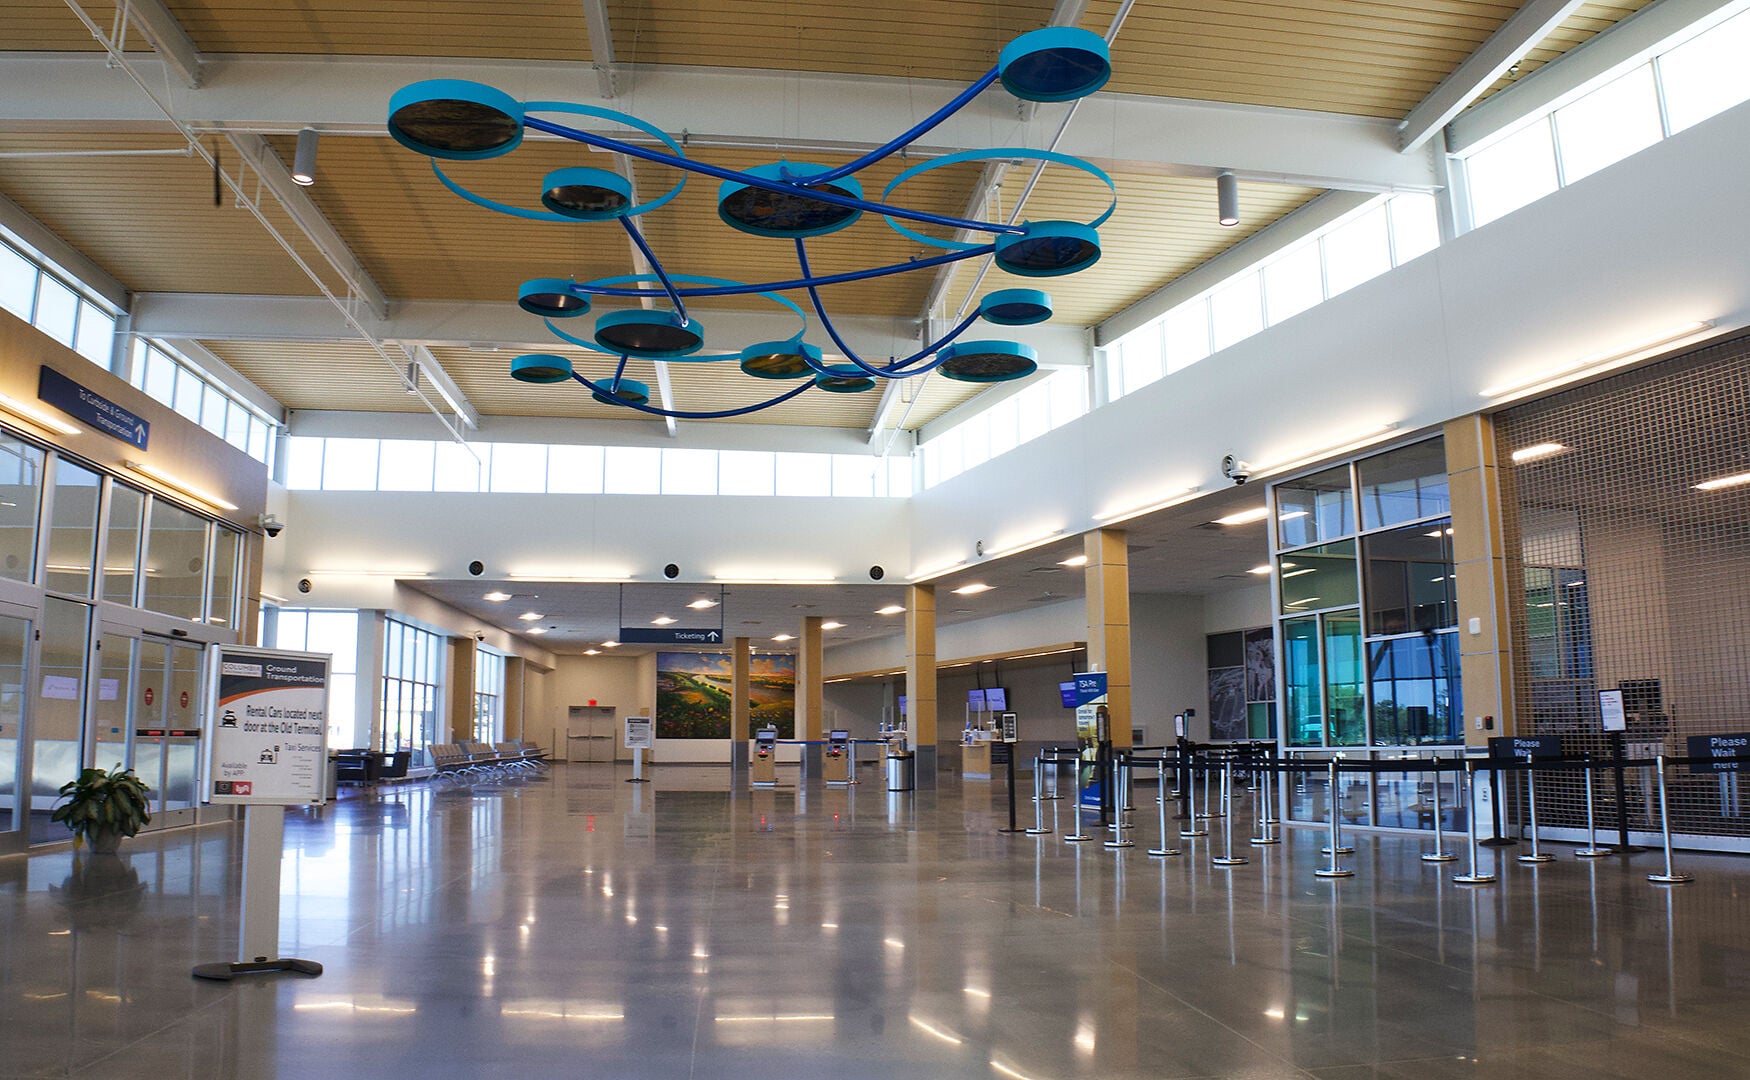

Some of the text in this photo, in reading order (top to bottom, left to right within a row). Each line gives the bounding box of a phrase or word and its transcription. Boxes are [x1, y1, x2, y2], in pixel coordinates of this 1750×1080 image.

[675, 632, 705, 641] Ticketing
[265, 664, 297, 674] Ground
[266, 672, 325, 683] Transportation
[246, 704, 323, 721] Rental Cars located next
[244, 720, 260, 733] door
[260, 723, 268, 733] at
[268, 721, 279, 734] the
[281, 721, 293, 734] Old
[1513, 738, 1540, 748] Please
[1710, 737, 1747, 747] Please
[298, 743, 322, 753] Services
[1711, 748, 1737, 758] Wait
[221, 761, 248, 770] Available
